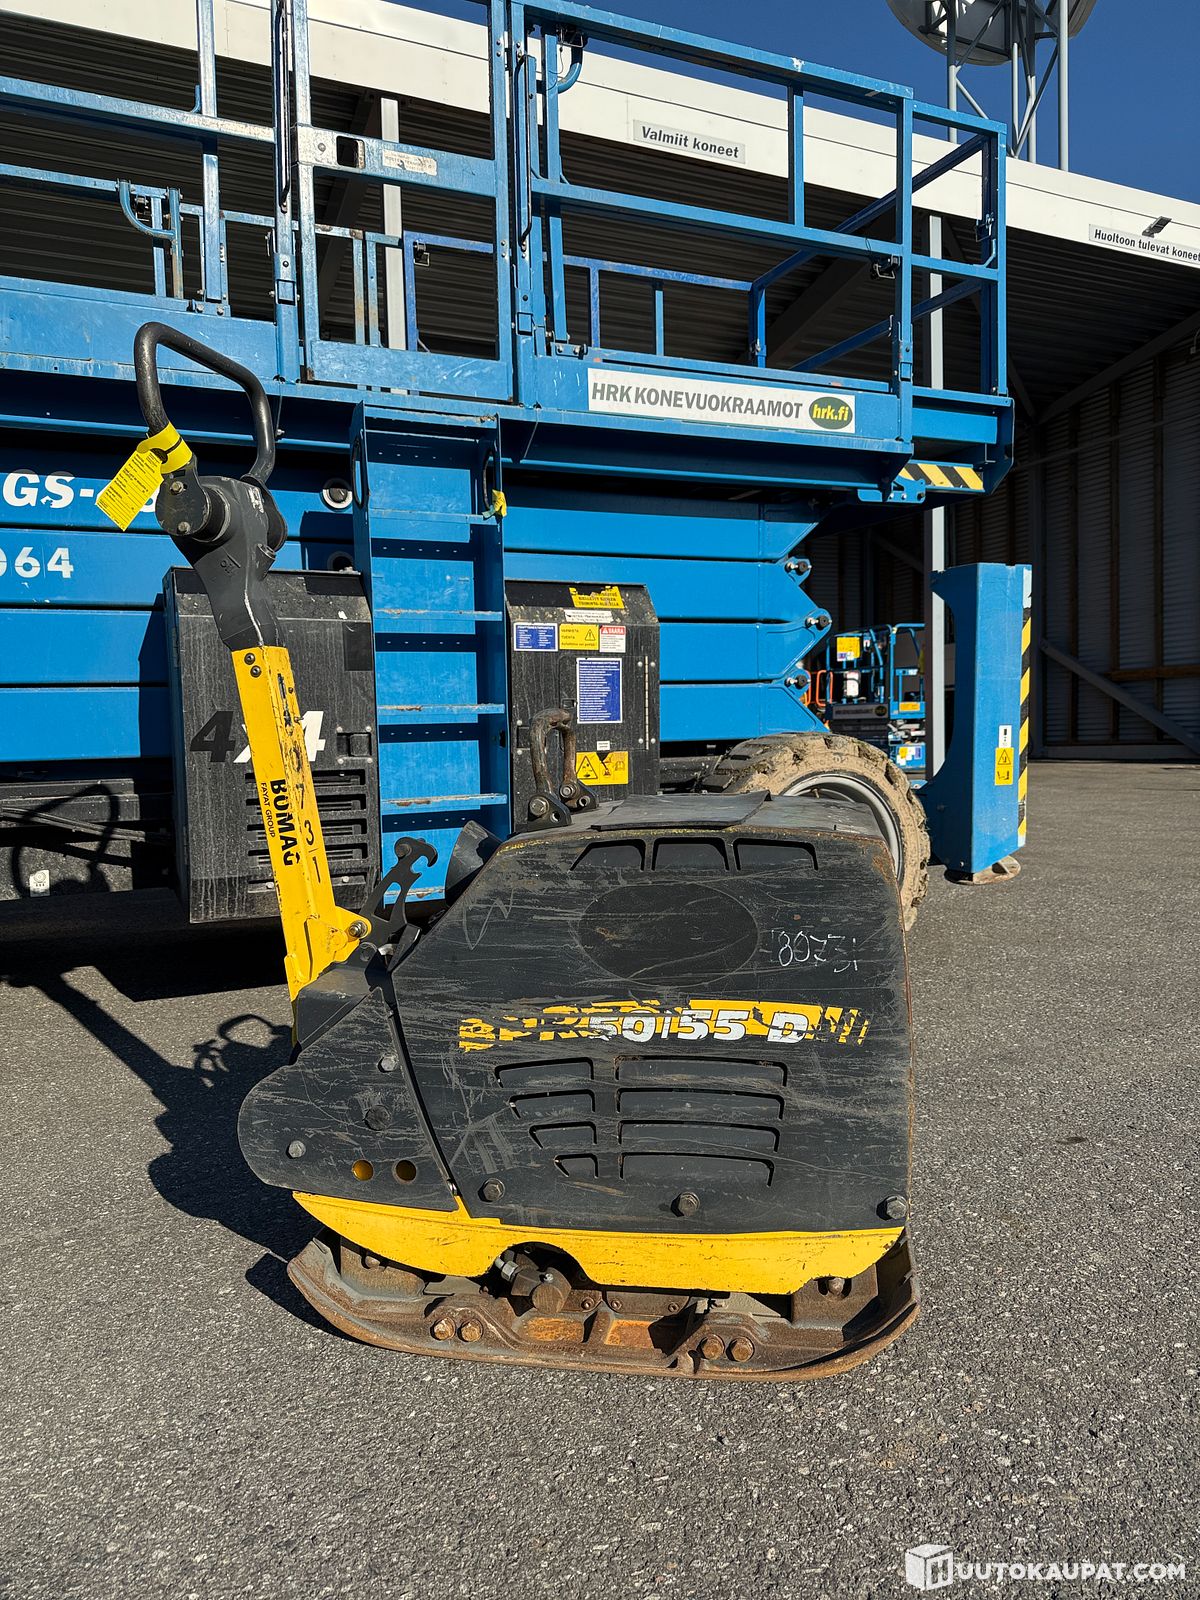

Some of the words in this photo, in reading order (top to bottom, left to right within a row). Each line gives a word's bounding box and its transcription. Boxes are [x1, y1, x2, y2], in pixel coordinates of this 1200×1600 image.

[642, 126, 689, 148] Valmiit
[692, 137, 739, 159] koneet
[1094, 228, 1136, 247] Huoltoon
[1138, 239, 1170, 255] tulevat
[591, 382, 633, 403] HRK
[634, 387, 803, 419] KONEVUOKRAAMOT
[812, 404, 849, 421] hrk.fi
[260, 782, 271, 807] FAYAT
[265, 809, 276, 838] GROUP
[270, 778, 301, 867] BOMAG
